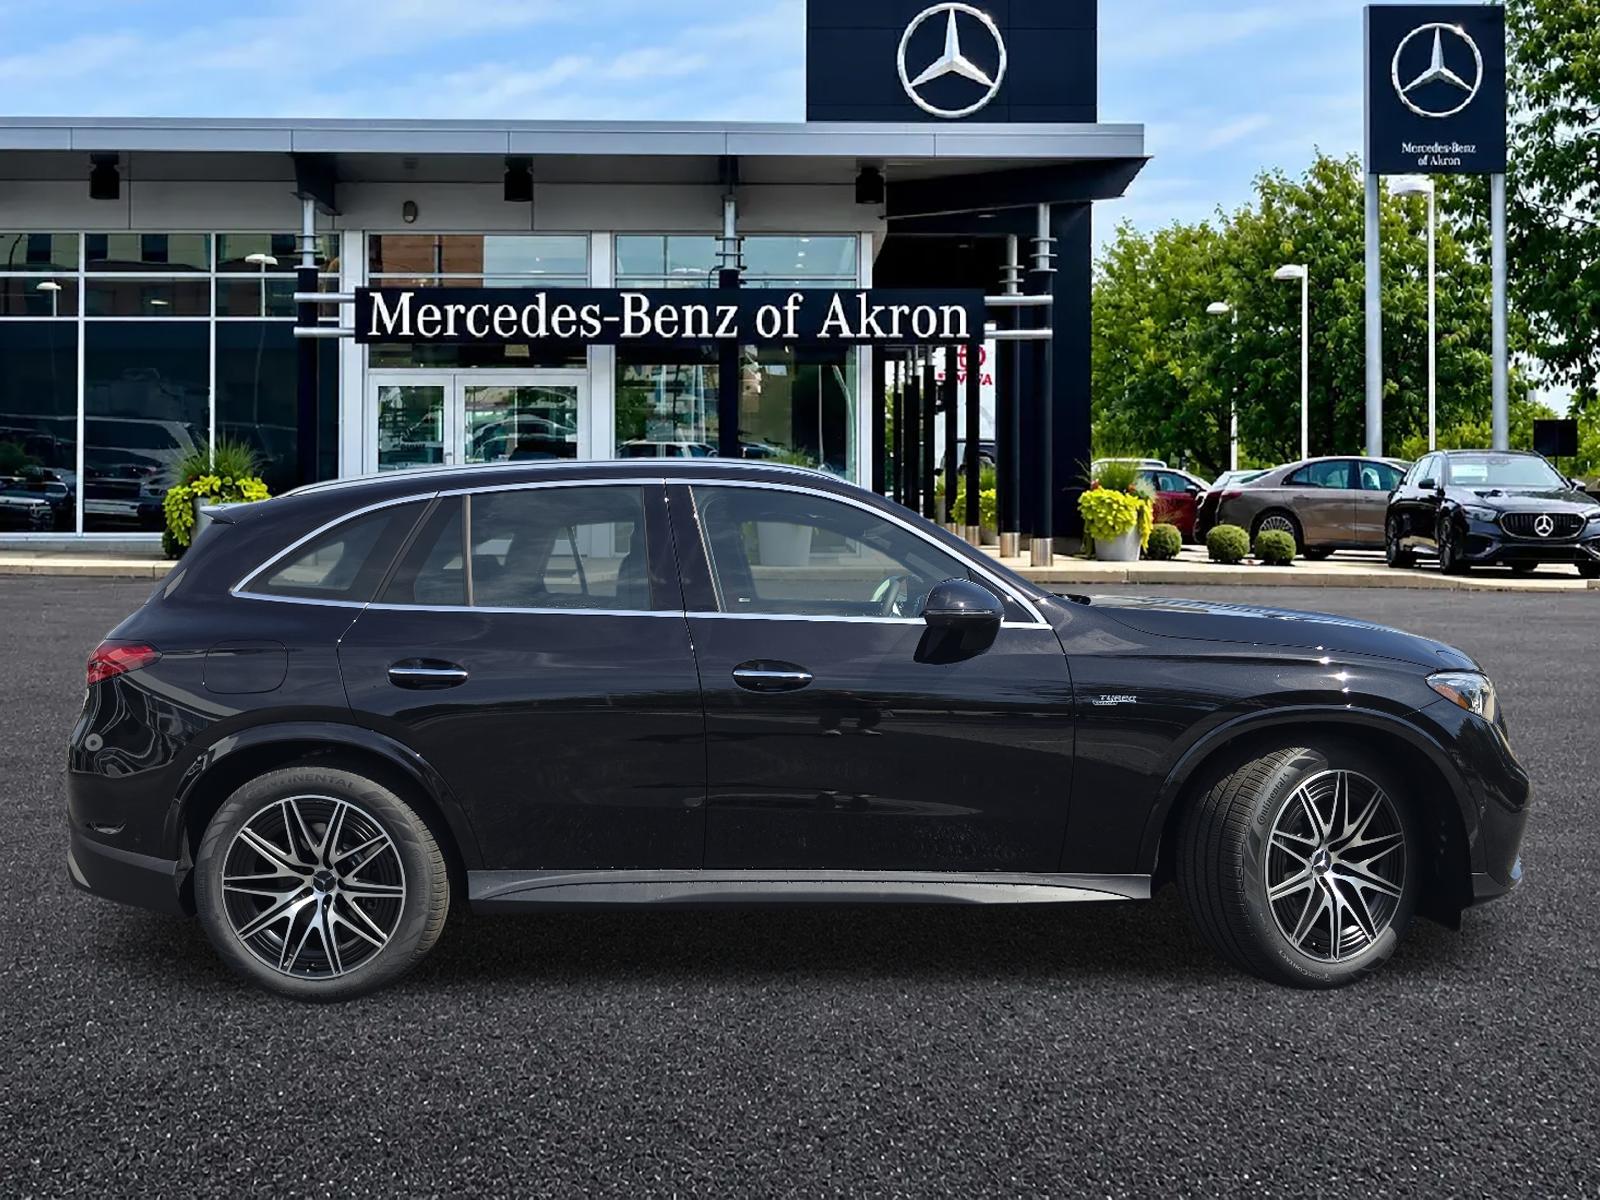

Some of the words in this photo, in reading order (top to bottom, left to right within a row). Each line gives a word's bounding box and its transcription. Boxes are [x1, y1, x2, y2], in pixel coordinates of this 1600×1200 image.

[1401, 142, 1476, 153] Mercedes-Benz
[1417, 154, 1428, 166] of
[1430, 154, 1461, 166] Akron
[367, 291, 738, 338] Mercedes-Benz
[755, 292, 804, 338] of
[816, 292, 970, 338] Akron
